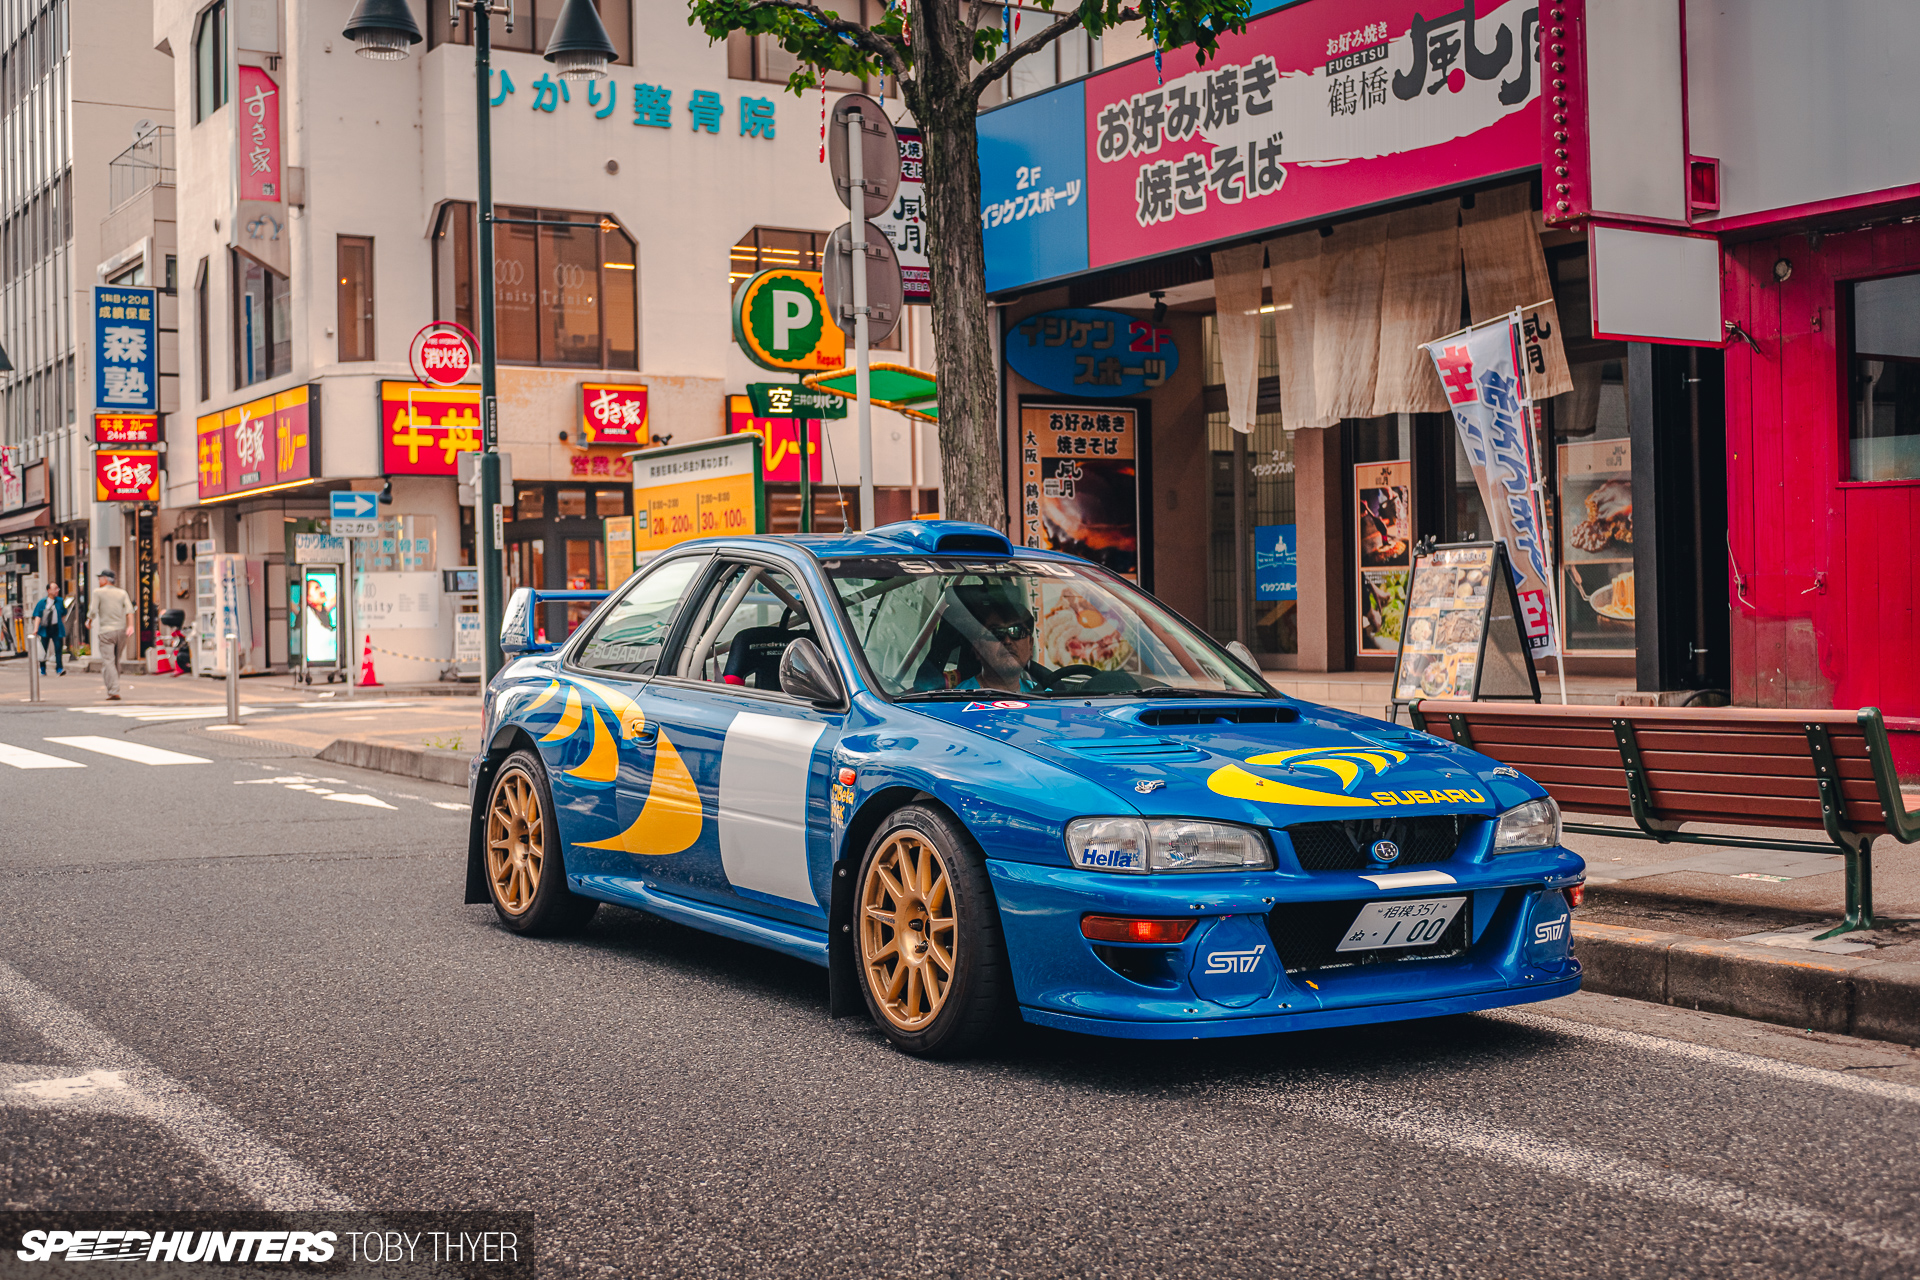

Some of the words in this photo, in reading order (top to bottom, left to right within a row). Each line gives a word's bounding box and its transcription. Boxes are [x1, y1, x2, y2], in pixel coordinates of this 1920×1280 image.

[1326, 21, 1388, 56] お好み焼き
[1328, 46, 1385, 74] FUGETSU
[489, 69, 776, 139] ひかり整骨院
[1327, 66, 1388, 117] 鶴橋
[1098, 57, 1279, 160] お好み焼き
[244, 85, 275, 176] すき家
[1015, 166, 1041, 190] 2F
[1137, 131, 1284, 223] 焼きそば
[980, 179, 1081, 230] イシケンスポーツ
[99, 305, 151, 321] 成績保証
[772, 289, 814, 350] P
[1019, 316, 1115, 349] イシケン
[1129, 320, 1173, 353] 2F
[103, 325, 149, 405] 森塾
[424, 347, 468, 369] 消火栓
[817, 350, 842, 366] Repark
[1074, 356, 1166, 387] スポーツ
[590, 389, 641, 429] すき家
[768, 387, 793, 413] 空
[793, 394, 844, 409] 三井のリパーク
[100, 419, 124, 431] 牛丼
[130, 419, 154, 431] カレー
[392, 406, 481, 465] 牛丼
[1049, 413, 1126, 433] お好み焼き
[235, 407, 265, 471] すき家
[278, 417, 308, 474] カレー
[1056, 435, 1119, 455] 焼きそば
[103, 455, 152, 488] すき家
[199, 433, 223, 488] 牛丼
[1251, 461, 1296, 477] イシケンスポ
[1056, 461, 1082, 498] 風月
[296, 533, 344, 549] ひかり整骨院
[335, 523, 376, 533] ここから
[897, 559, 1076, 577] SUBARU
[592, 644, 649, 662] SUBARU
[749, 641, 790, 650] prodriv
[1371, 788, 1486, 806] SUBARU
[1082, 848, 1132, 868] Hella
